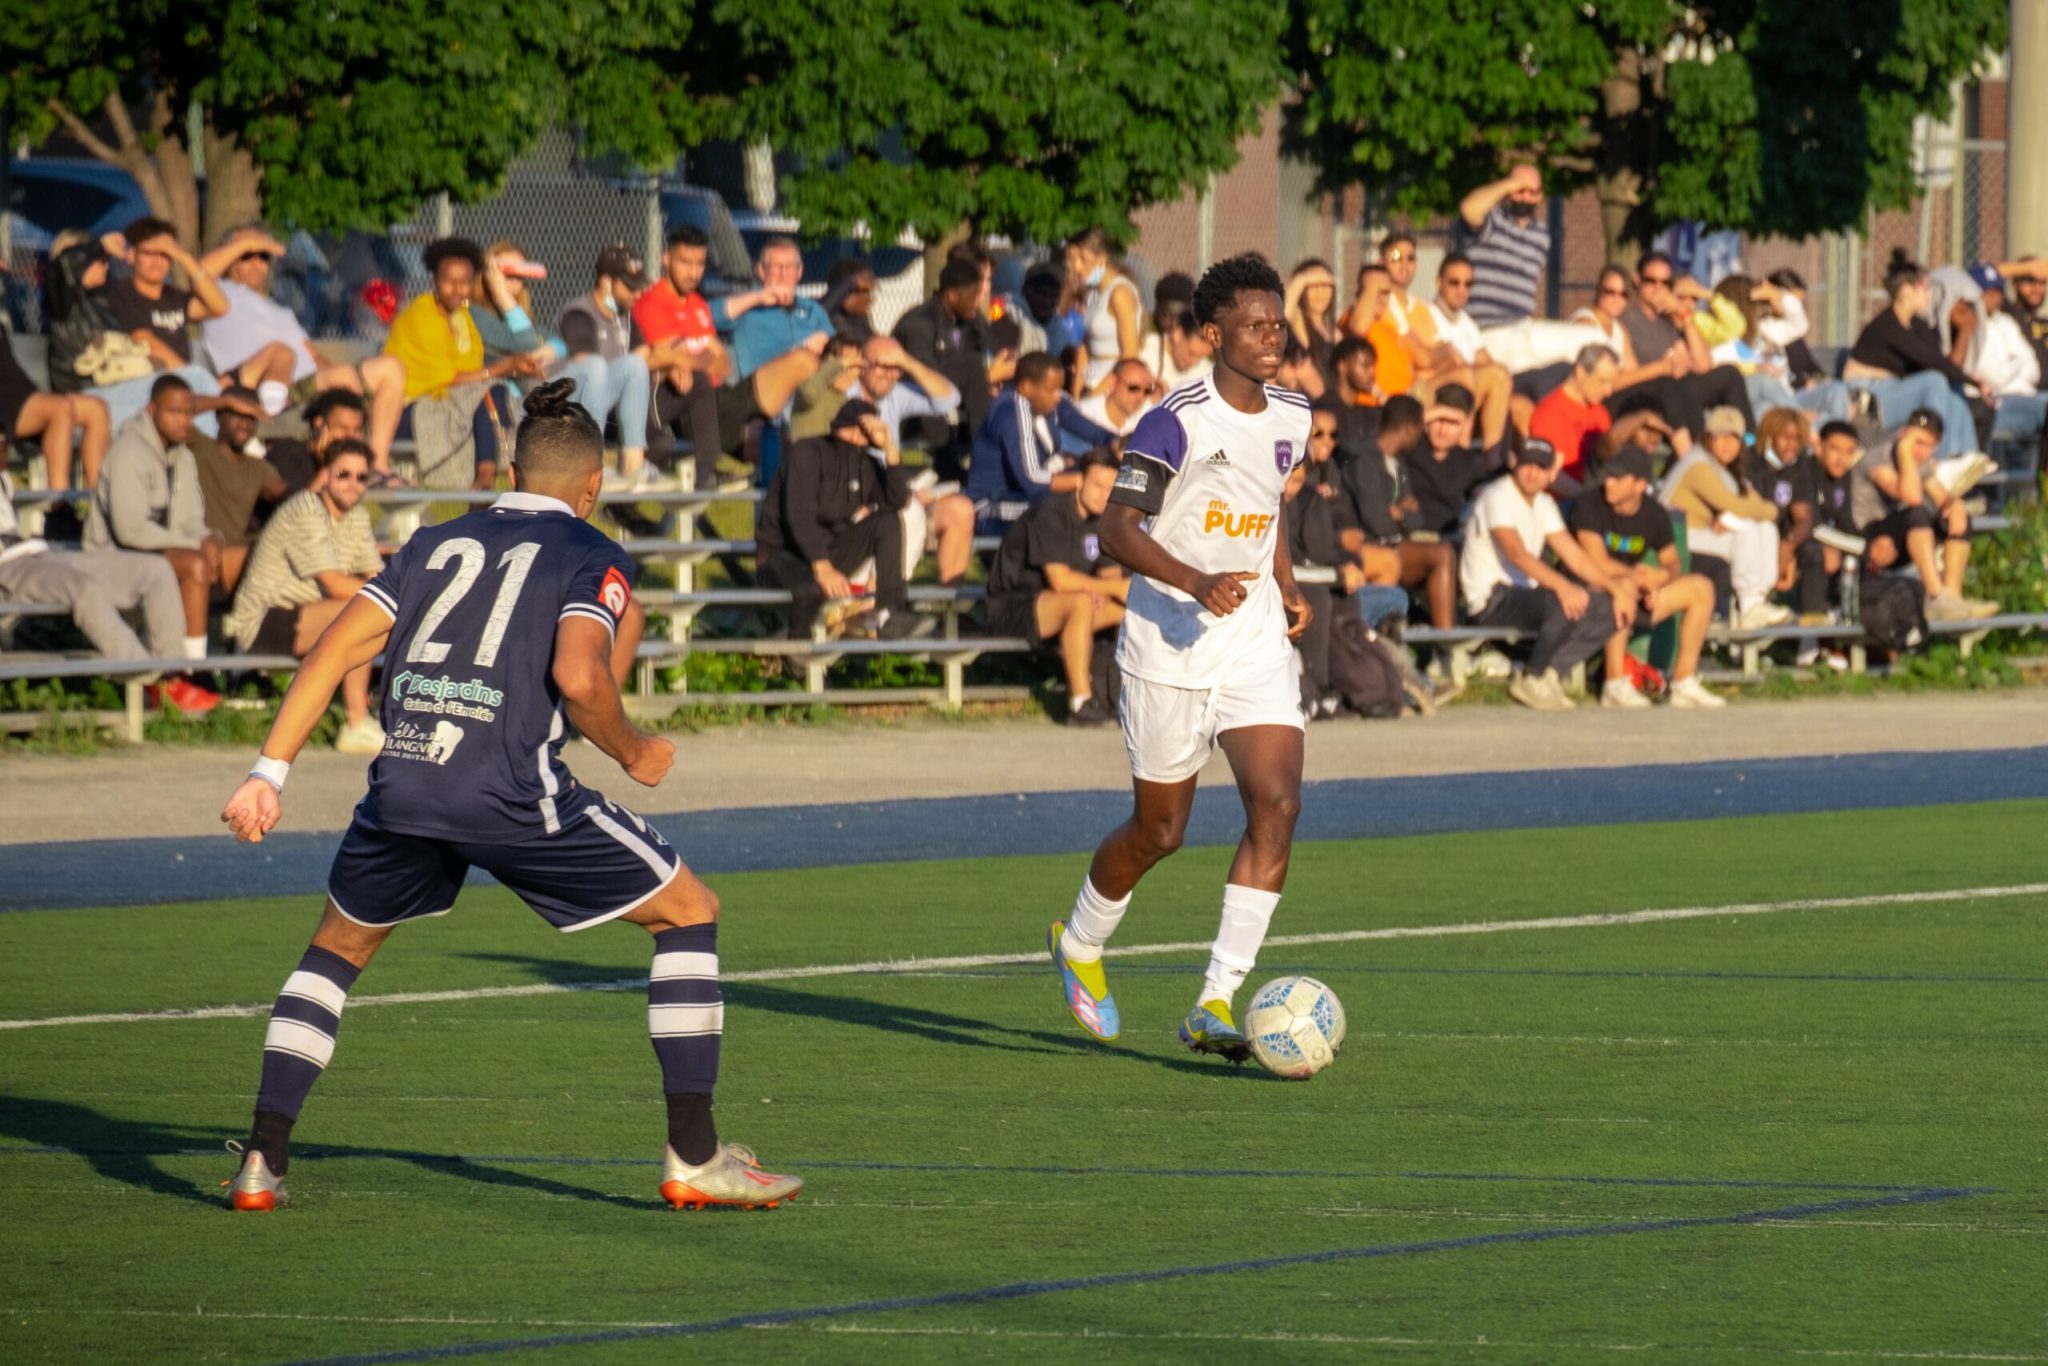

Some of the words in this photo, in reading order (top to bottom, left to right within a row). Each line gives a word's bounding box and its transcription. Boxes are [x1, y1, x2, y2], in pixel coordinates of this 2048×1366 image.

[1208, 499, 1230, 511] mr.
[406, 537, 542, 668] 21
[407, 675, 504, 707] Desjardins
